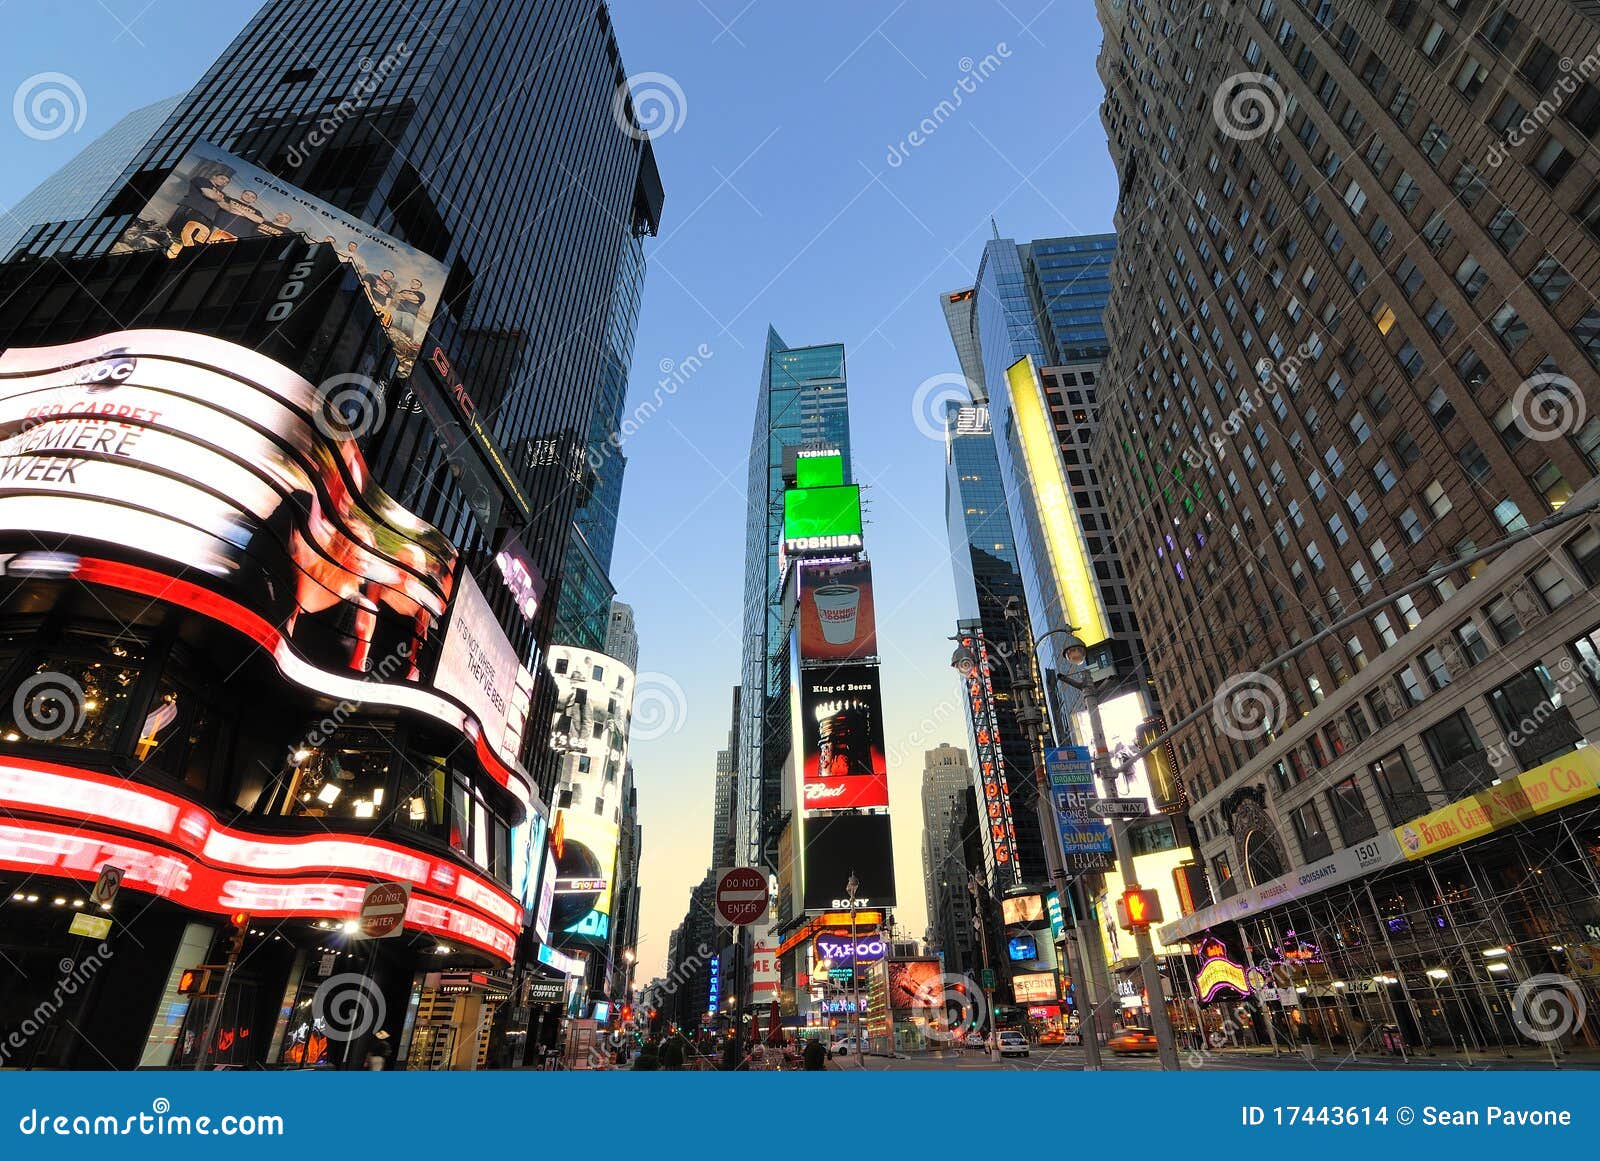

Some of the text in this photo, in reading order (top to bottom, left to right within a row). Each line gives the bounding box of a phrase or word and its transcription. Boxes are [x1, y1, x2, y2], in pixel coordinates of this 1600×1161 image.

[254, 177, 288, 196] GRAB
[292, 196, 319, 212] LIFE
[321, 210, 338, 221] BY
[341, 220, 362, 234] THE
[265, 243, 320, 321] 1500
[433, 346, 474, 421] GMC
[55, 401, 163, 433] CARPET
[797, 449, 841, 458] TOSHIBA
[0, 455, 89, 484] WEEK
[786, 534, 862, 550] TOSHIBA
[468, 652, 507, 717] THEY'VE BEEN
[813, 683, 872, 693] King of Beers
[1054, 775, 1090, 784] BROADWAY
[803, 782, 846, 799] Bud
[981, 761, 1010, 863] YOUNG
[1095, 803, 1141, 813] ONE WAY
[1419, 820, 1461, 846] BUBBA
[1456, 806, 1494, 831] GUMP
[1493, 781, 1549, 815] SHRIMP
[1063, 832, 1106, 844] SUNDAY
[1354, 841, 1380, 862] 1501
[1298, 864, 1337, 886] CROISSANTS
[726, 879, 760, 888] DO NOT
[371, 893, 402, 904] DO NOT
[727, 903, 757, 914] ENTER
[367, 917, 394, 927] ENTER
[530, 984, 563, 992] TARBUCKS
[709, 959, 719, 1011] NYGARD
[532, 990, 556, 998] COFFEE
[839, 999, 857, 1012] YOR
